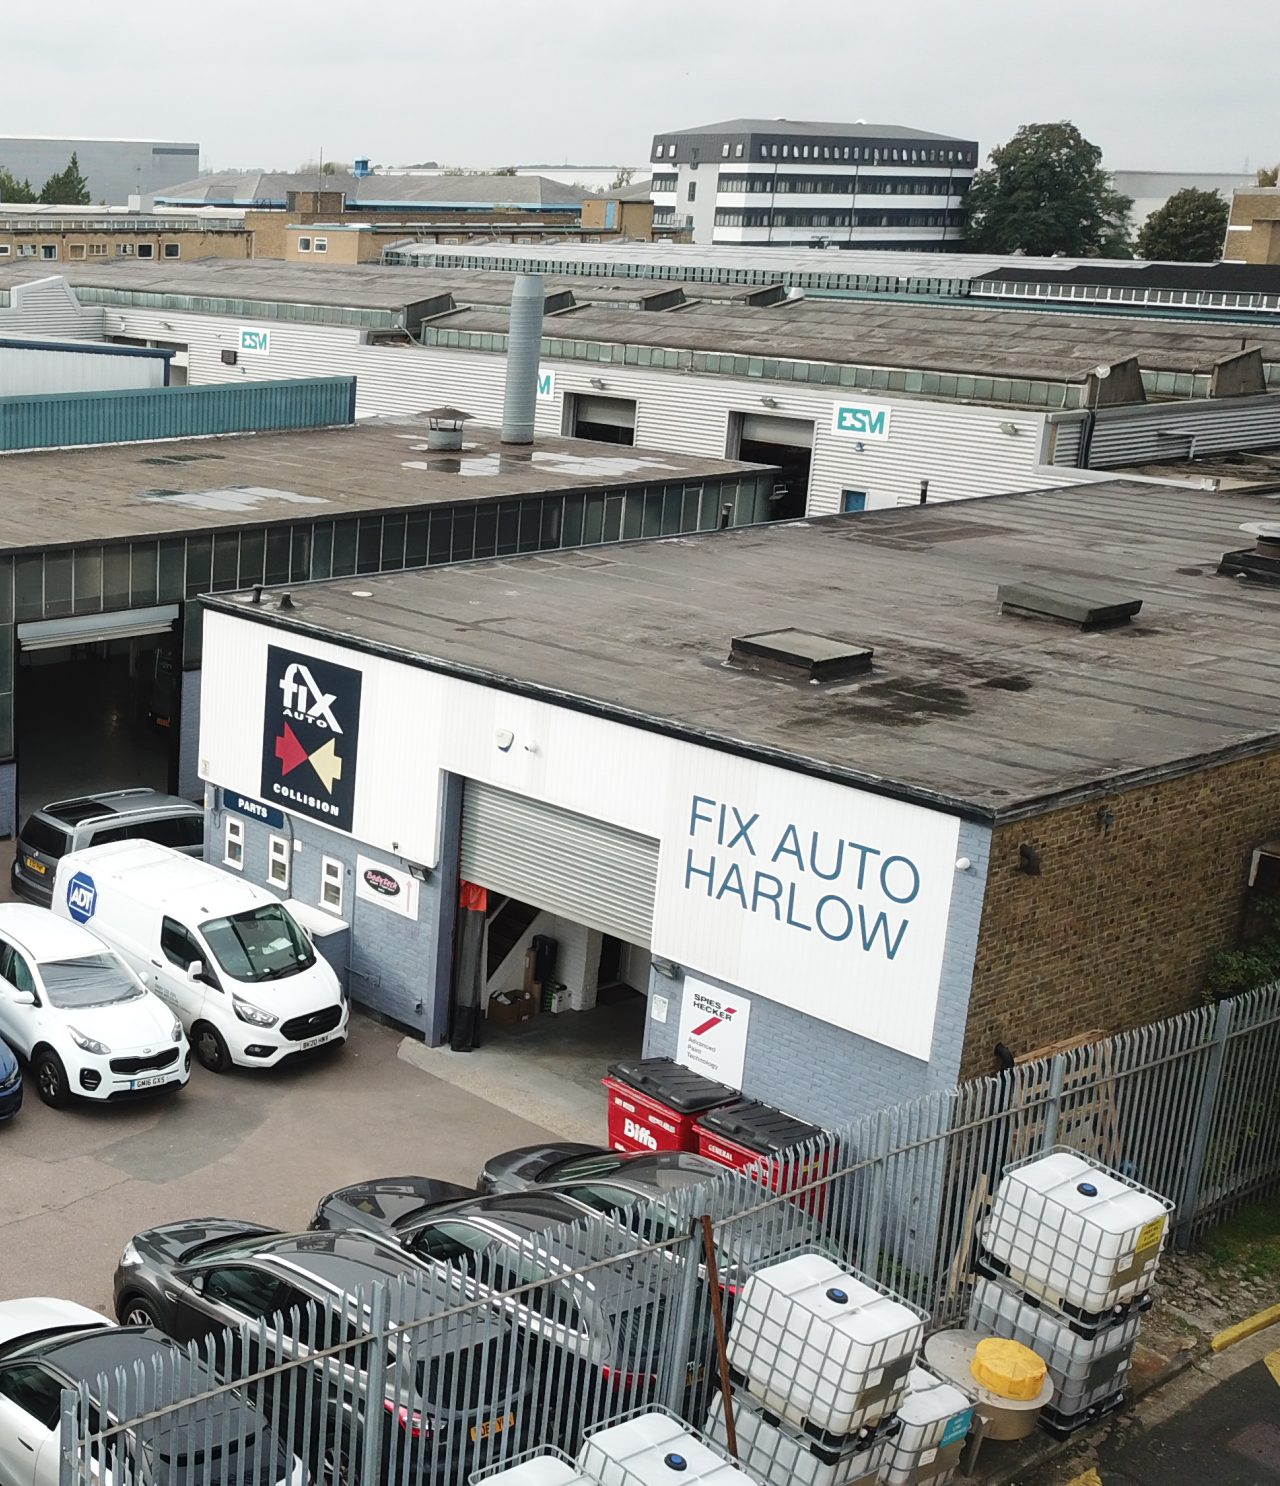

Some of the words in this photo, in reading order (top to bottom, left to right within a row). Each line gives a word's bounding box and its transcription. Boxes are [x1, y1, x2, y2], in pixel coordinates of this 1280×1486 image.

[241, 331, 267, 350] ESM
[837, 407, 885, 435] ESM
[282, 708, 328, 728] AUTO
[238, 797, 268, 818] PARTS
[273, 783, 340, 817] COLLISION
[689, 794, 760, 856] FIX
[771, 823, 920, 904] AUTO
[71, 886, 94, 911] ADT
[684, 848, 909, 960] HARLOW
[693, 1001, 733, 1022] HECKER
[694, 993, 722, 1010] SPIES
[688, 1036, 717, 1053] Advanced
[623, 1117, 658, 1151] Biffa
[707, 1144, 733, 1162] GENERAL
